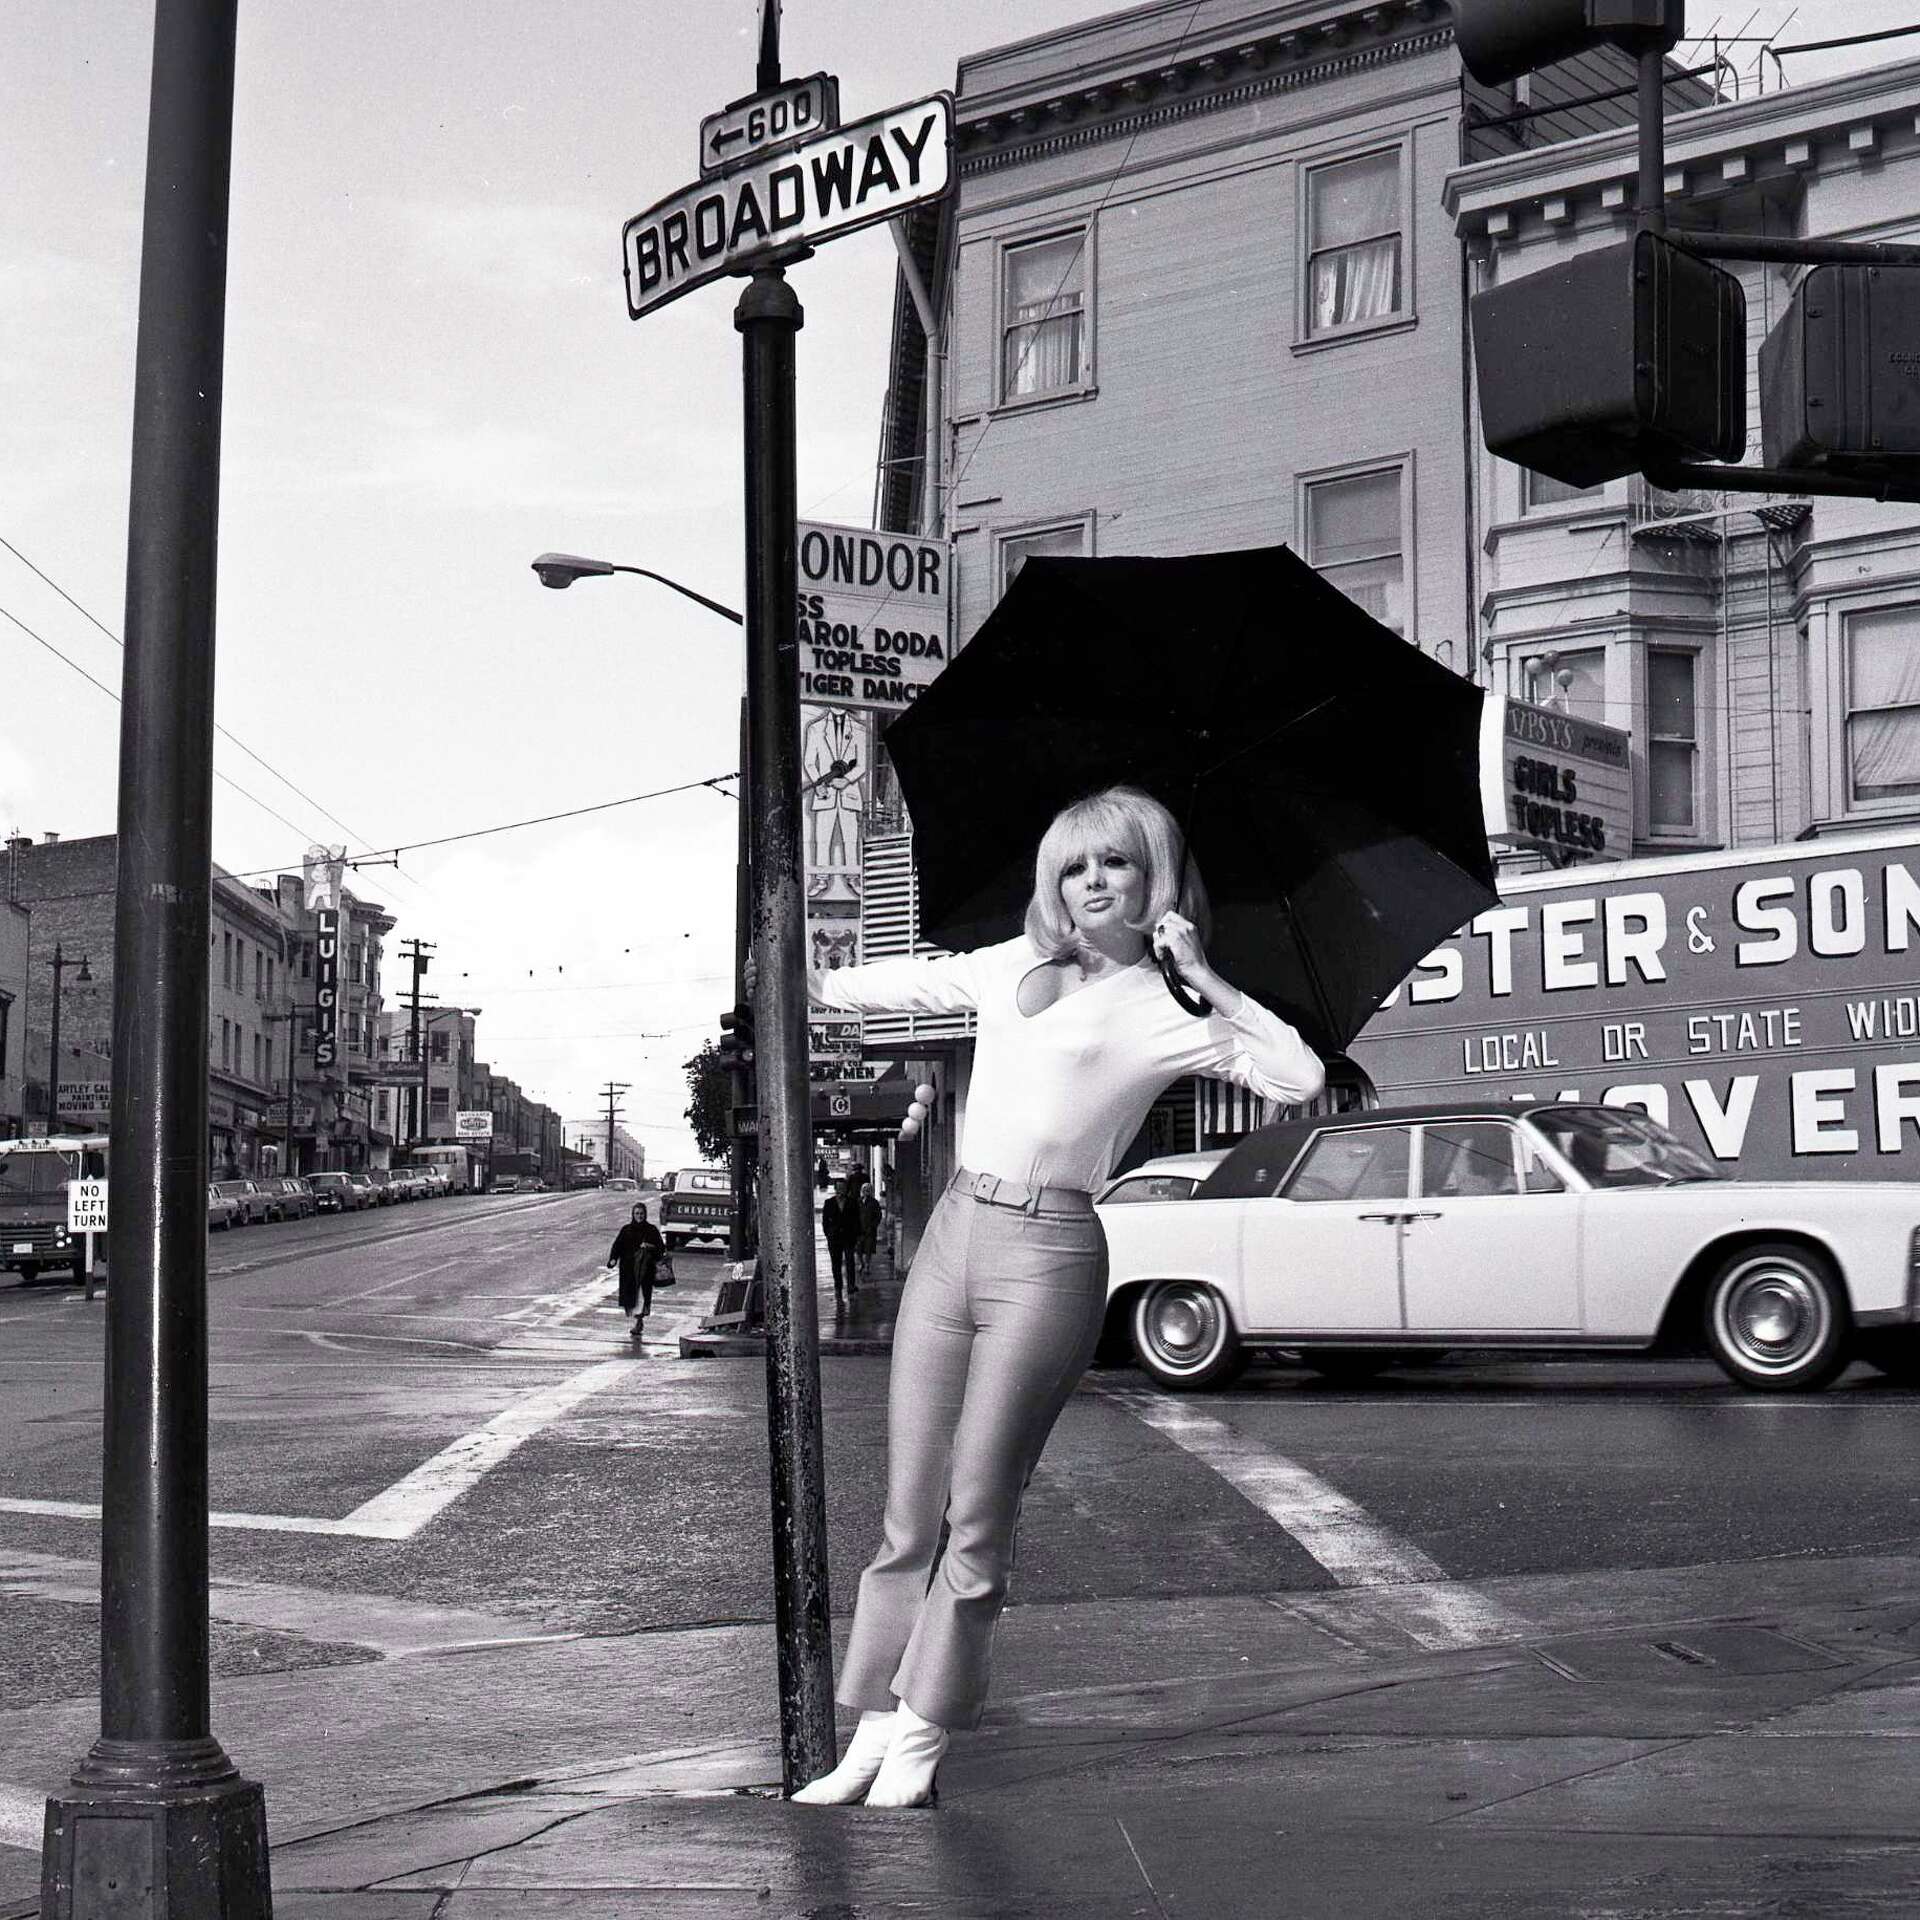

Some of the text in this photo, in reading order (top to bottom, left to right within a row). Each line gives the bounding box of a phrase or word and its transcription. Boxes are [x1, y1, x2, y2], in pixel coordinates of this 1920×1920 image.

[748, 91, 811, 143] 600
[636, 114, 937, 294] BROADWAY
[812, 648, 902, 677] TOPLESS
[874, 628, 944, 660] DODA
[1514, 756, 1577, 804] GIRLS
[1512, 794, 1605, 851] TOPLESS
[1380, 893, 1667, 1009] STER
[1685, 905, 1716, 954] &
[316, 913, 336, 1063] LUIGI'S
[1464, 1031, 1559, 1075] LOCAL
[1603, 1023, 1648, 1062] OR
[1689, 1007, 1802, 1054] STATE
[1509, 1063, 1920, 1160] OVER
[75, 1200, 105, 1212] LEFT
[80, 1186, 100, 1197] NO
[677, 1205, 731, 1216] CHEVROLE
[73, 1215, 106, 1227] TURN
